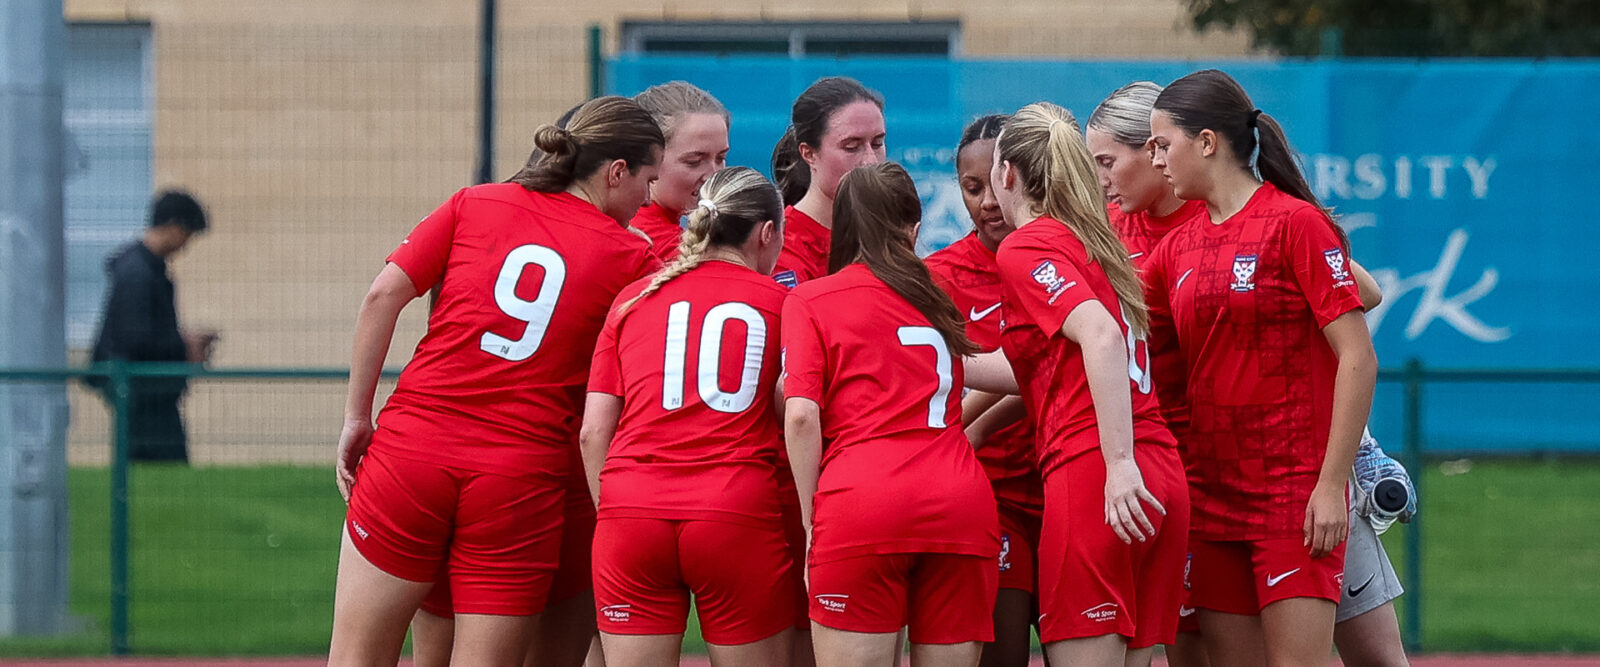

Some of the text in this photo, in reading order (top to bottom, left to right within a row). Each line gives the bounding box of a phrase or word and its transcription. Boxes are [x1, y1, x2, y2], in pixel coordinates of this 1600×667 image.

[1313, 152, 1498, 200] RSITY
[479, 243, 567, 362] 9
[662, 299, 768, 413] 10
[896, 325, 953, 428] 7
